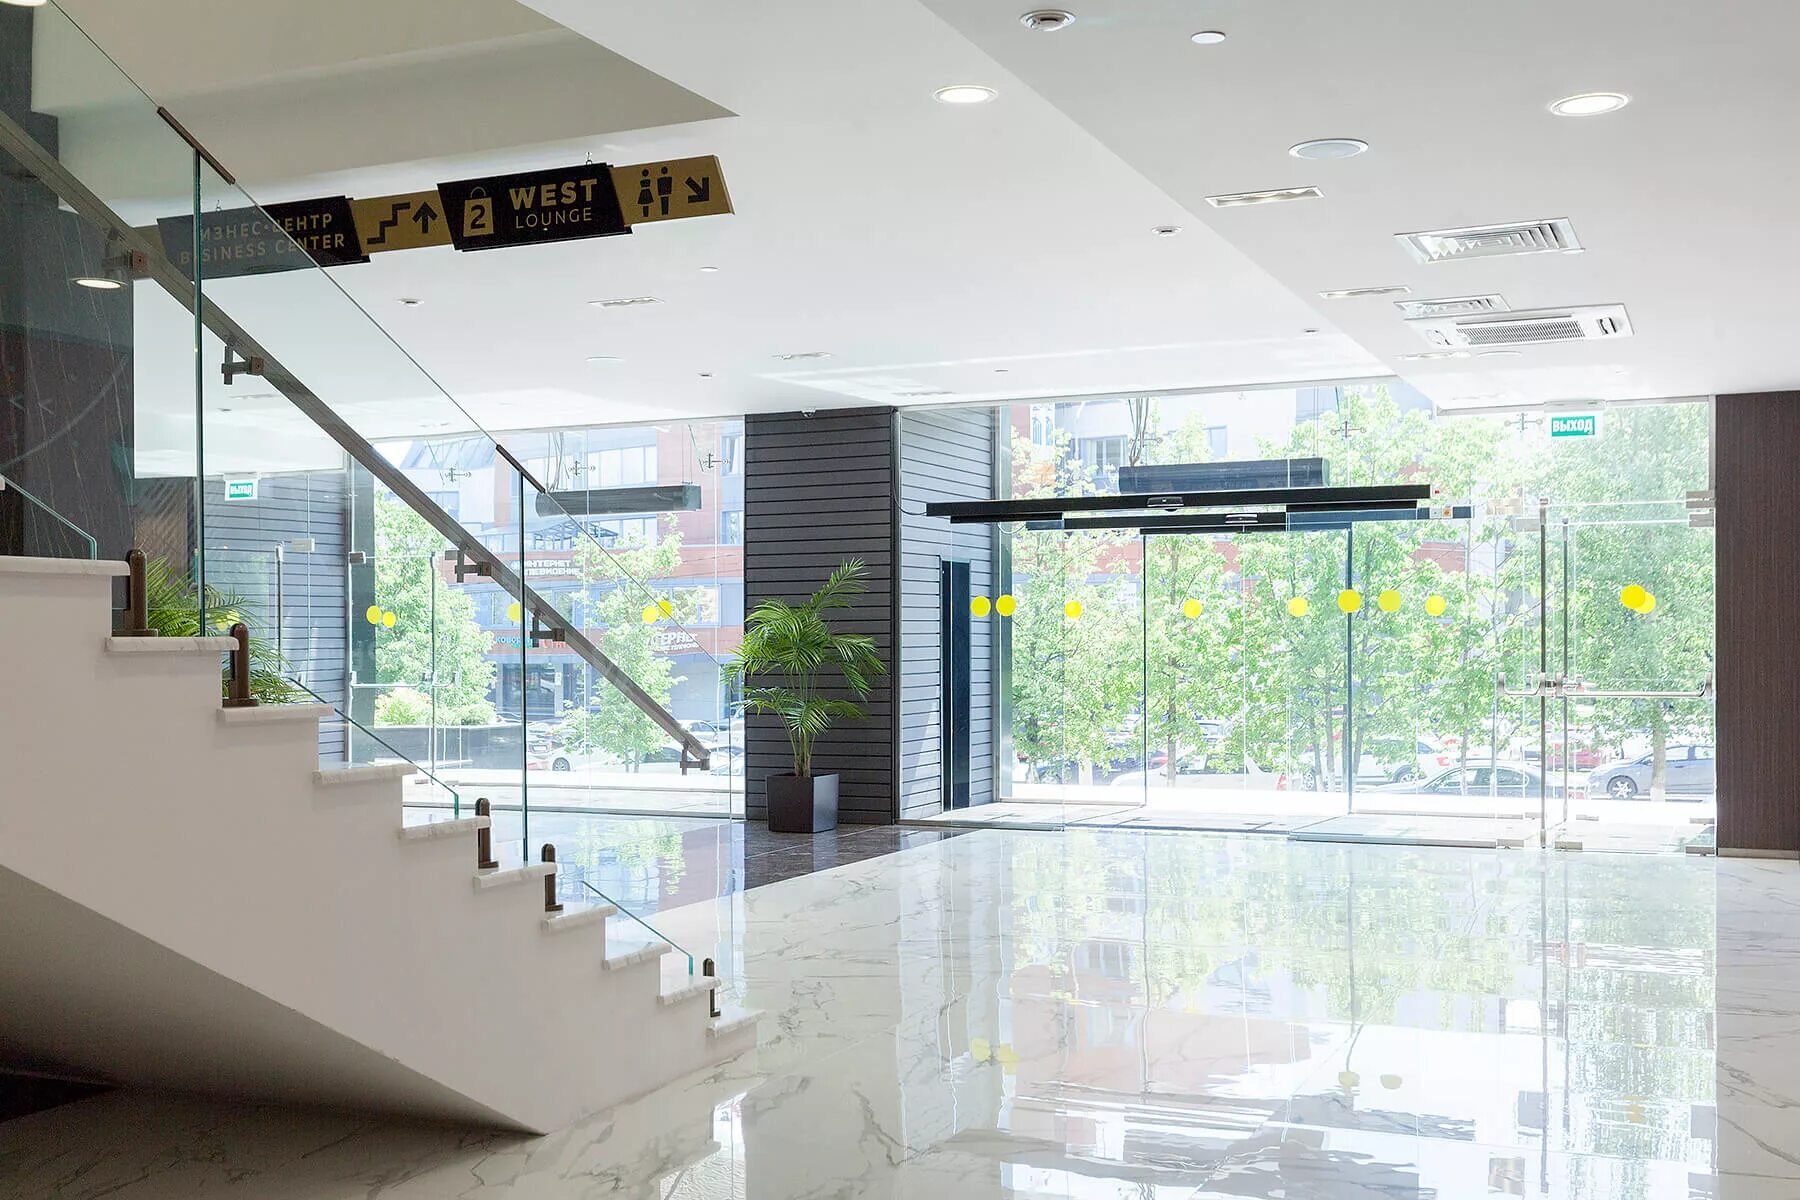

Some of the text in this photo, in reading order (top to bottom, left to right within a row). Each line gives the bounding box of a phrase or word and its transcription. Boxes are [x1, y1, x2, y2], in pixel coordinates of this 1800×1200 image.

[509, 178, 598, 210] WEST
[470, 204, 486, 229] 2
[516, 207, 592, 229] LOUNGE
[180, 241, 266, 265] BSINESS
